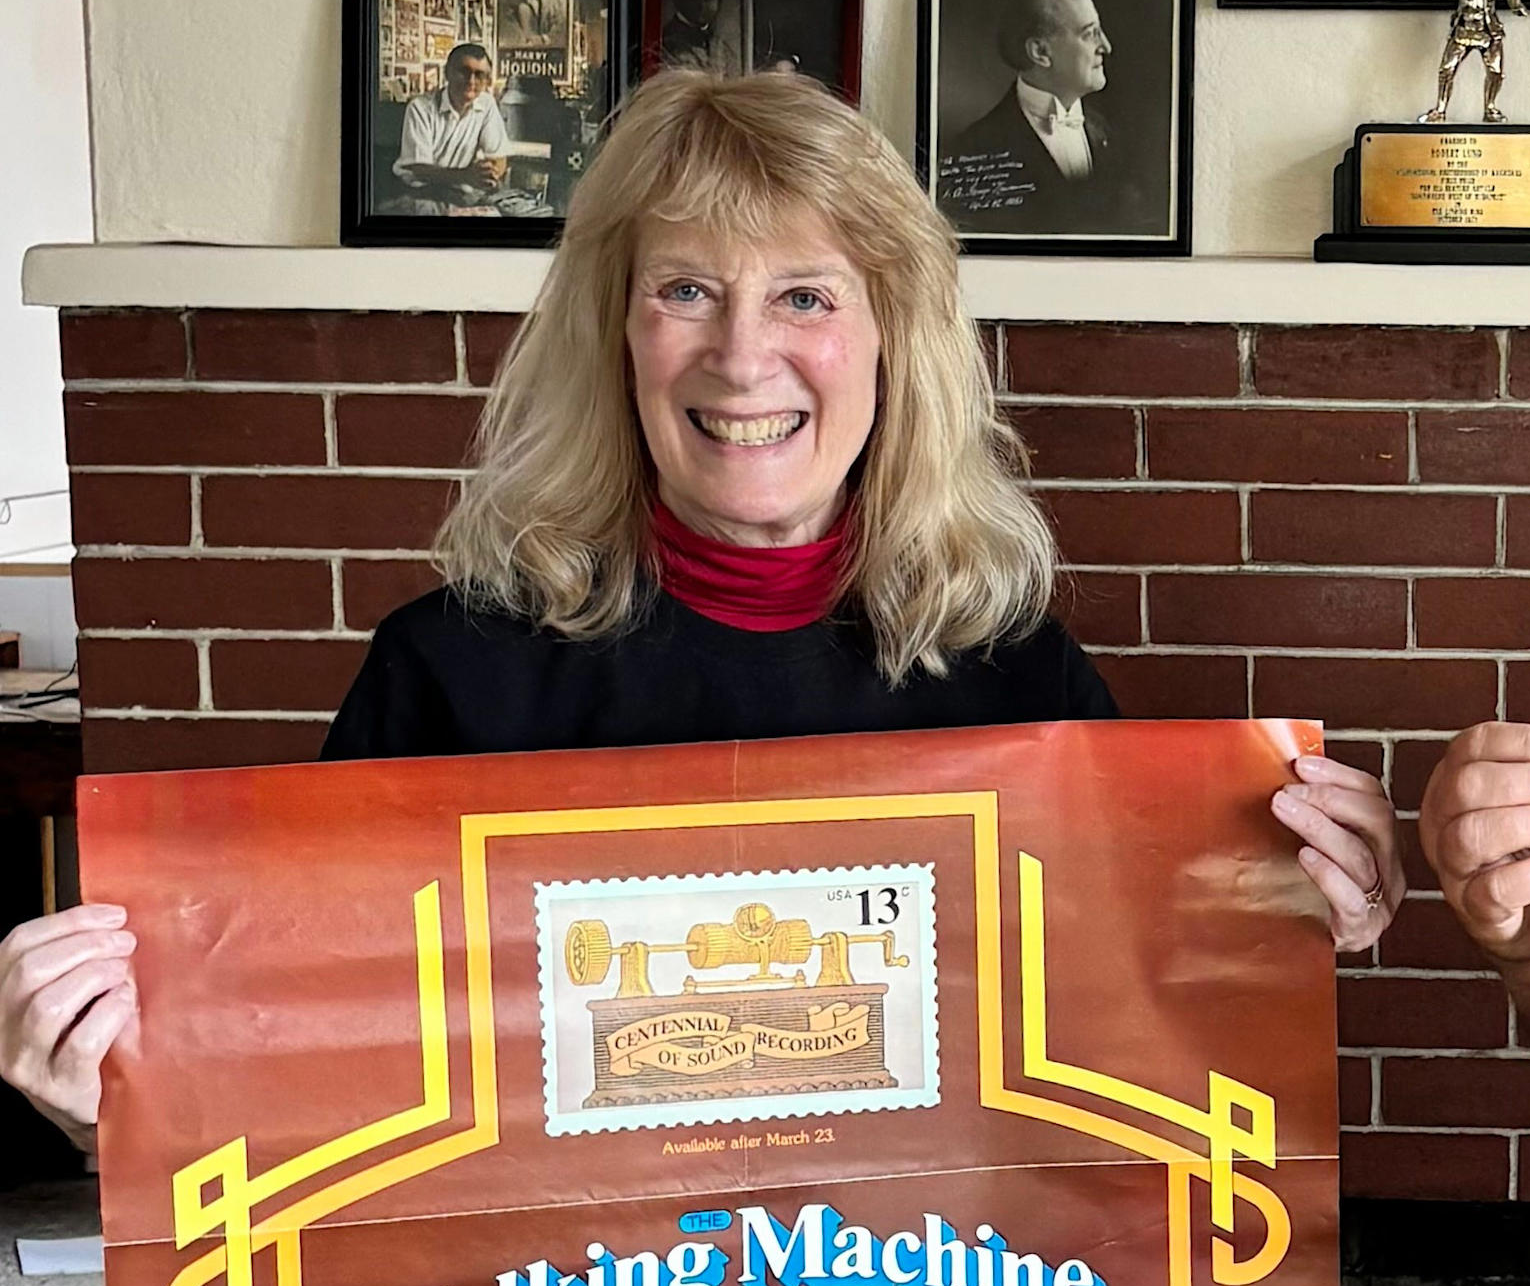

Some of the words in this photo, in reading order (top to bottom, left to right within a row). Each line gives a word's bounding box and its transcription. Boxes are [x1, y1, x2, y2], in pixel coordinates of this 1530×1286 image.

[514, 50, 548, 60] HARRY
[500, 59, 564, 76] HOUDINI
[827, 889, 853, 902] USA
[614, 1016, 725, 1051] CENTENNIAL
[757, 1027, 858, 1053] RECORDING
[658, 1050, 681, 1065] OF
[687, 1041, 747, 1068] SOUND
[662, 1137, 727, 1156] Available
[730, 1133, 762, 1151] after
[765, 1130, 810, 1148] March
[684, 1214, 727, 1230] THE
